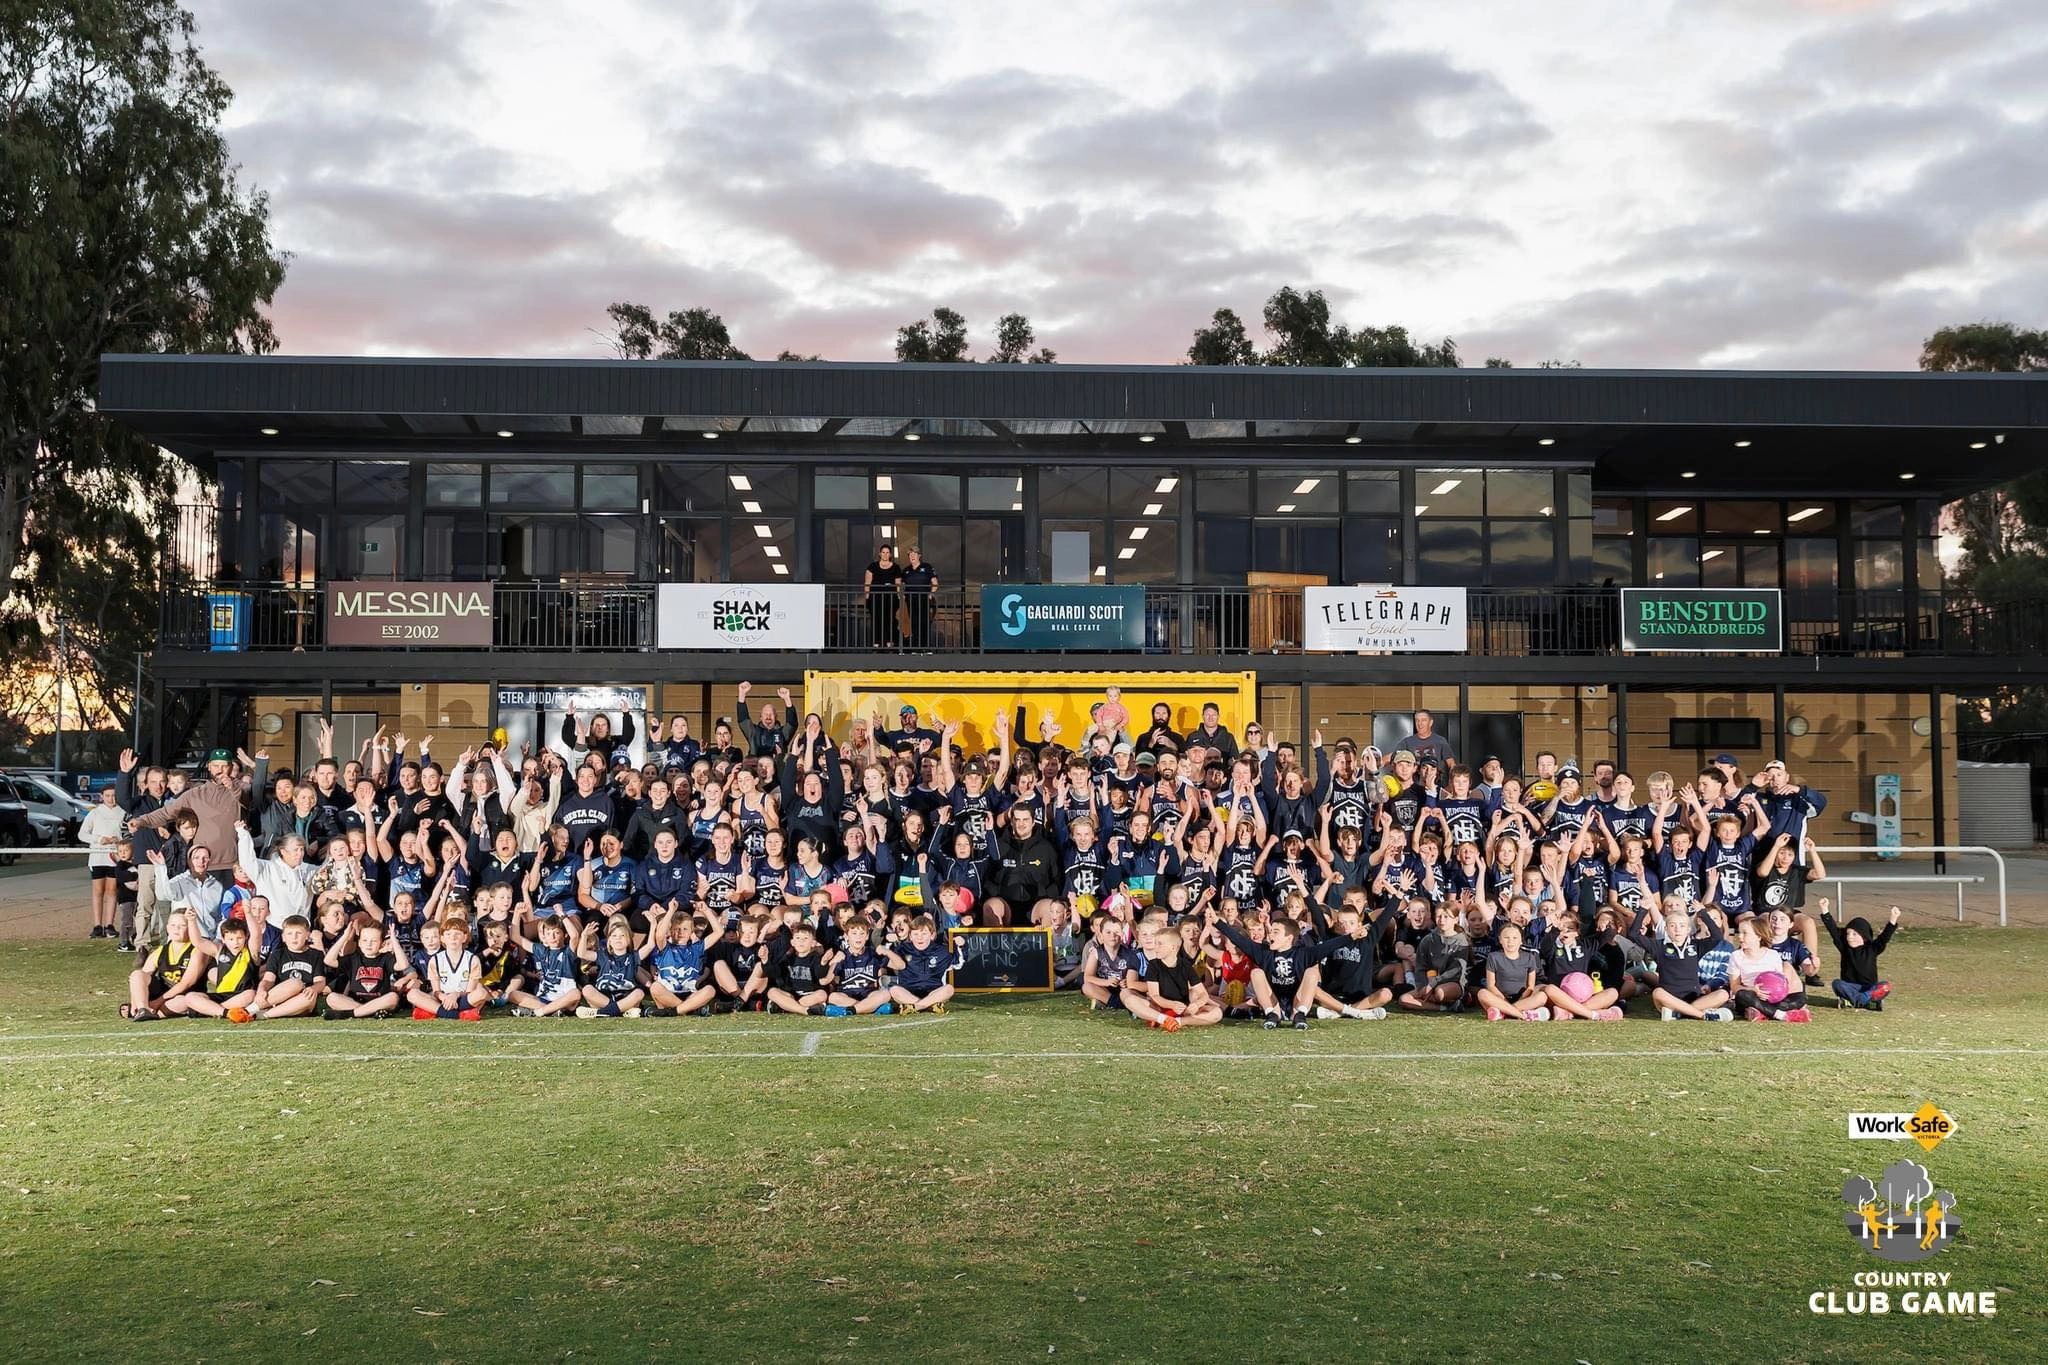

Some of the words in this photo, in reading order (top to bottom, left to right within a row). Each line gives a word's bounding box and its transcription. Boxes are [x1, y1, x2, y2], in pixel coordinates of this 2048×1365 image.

[334, 592, 490, 616] MESSINA
[713, 600, 771, 615] SHAM
[1640, 601, 1767, 621] BENSTUD
[1027, 605, 1085, 620] GAGLIARDI
[1089, 605, 1124, 620] SCOTT
[1321, 600, 1451, 626] TELEGRAPH
[713, 615, 770, 632] RCK
[1366, 621, 1408, 636] Hotel
[1639, 622, 1766, 635] STANDARDBREDS
[382, 625, 401, 638] EST
[404, 624, 440, 639] 2002
[727, 634, 758, 643] HOTEL
[498, 691, 524, 704] ETER
